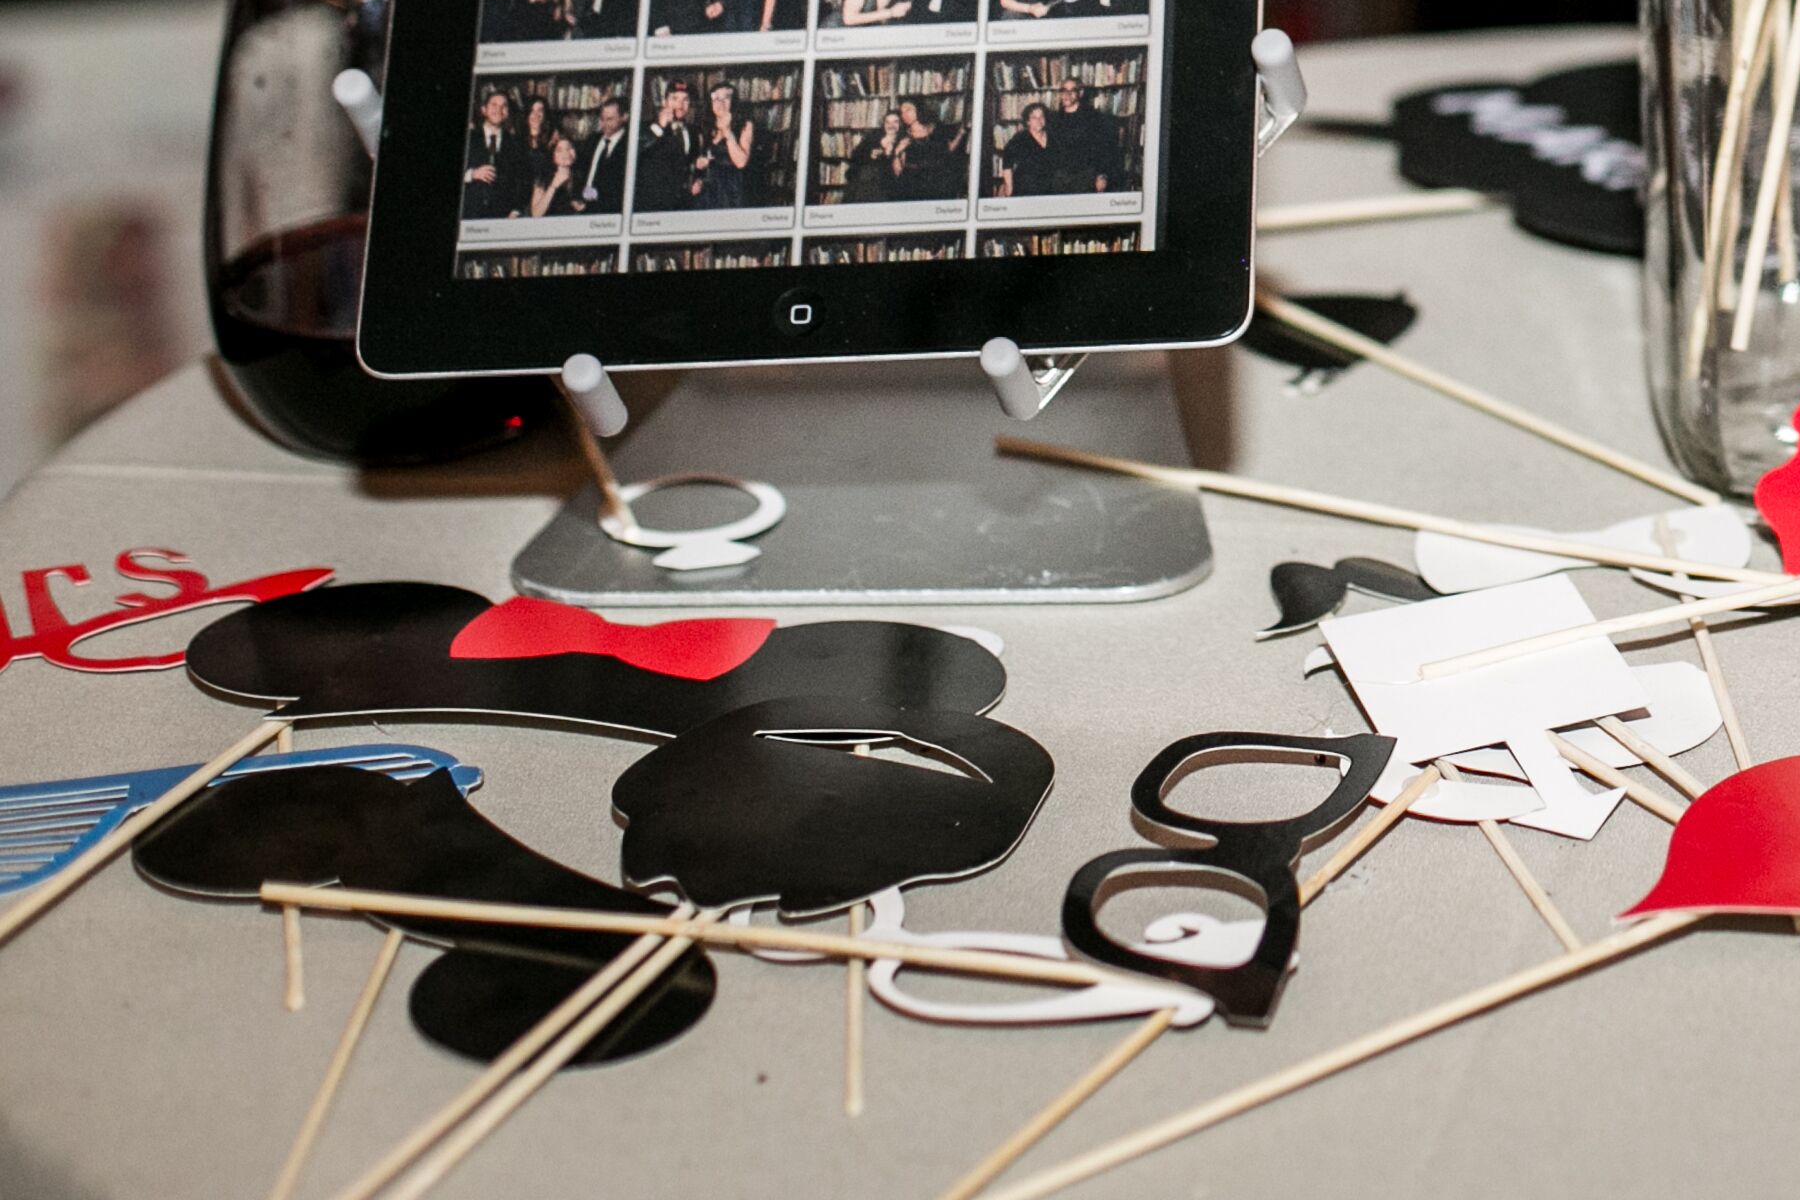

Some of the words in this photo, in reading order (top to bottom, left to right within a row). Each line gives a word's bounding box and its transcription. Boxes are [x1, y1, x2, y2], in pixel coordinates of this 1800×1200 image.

[1109, 197, 1137, 208] Delete
[936, 205, 963, 215] Delete
[982, 203, 1008, 213] Share
[762, 213, 789, 223] Delete
[810, 211, 834, 220] Share
[589, 220, 616, 230] Delete
[637, 218, 660, 227] Share
[465, 225, 489, 234] Share
